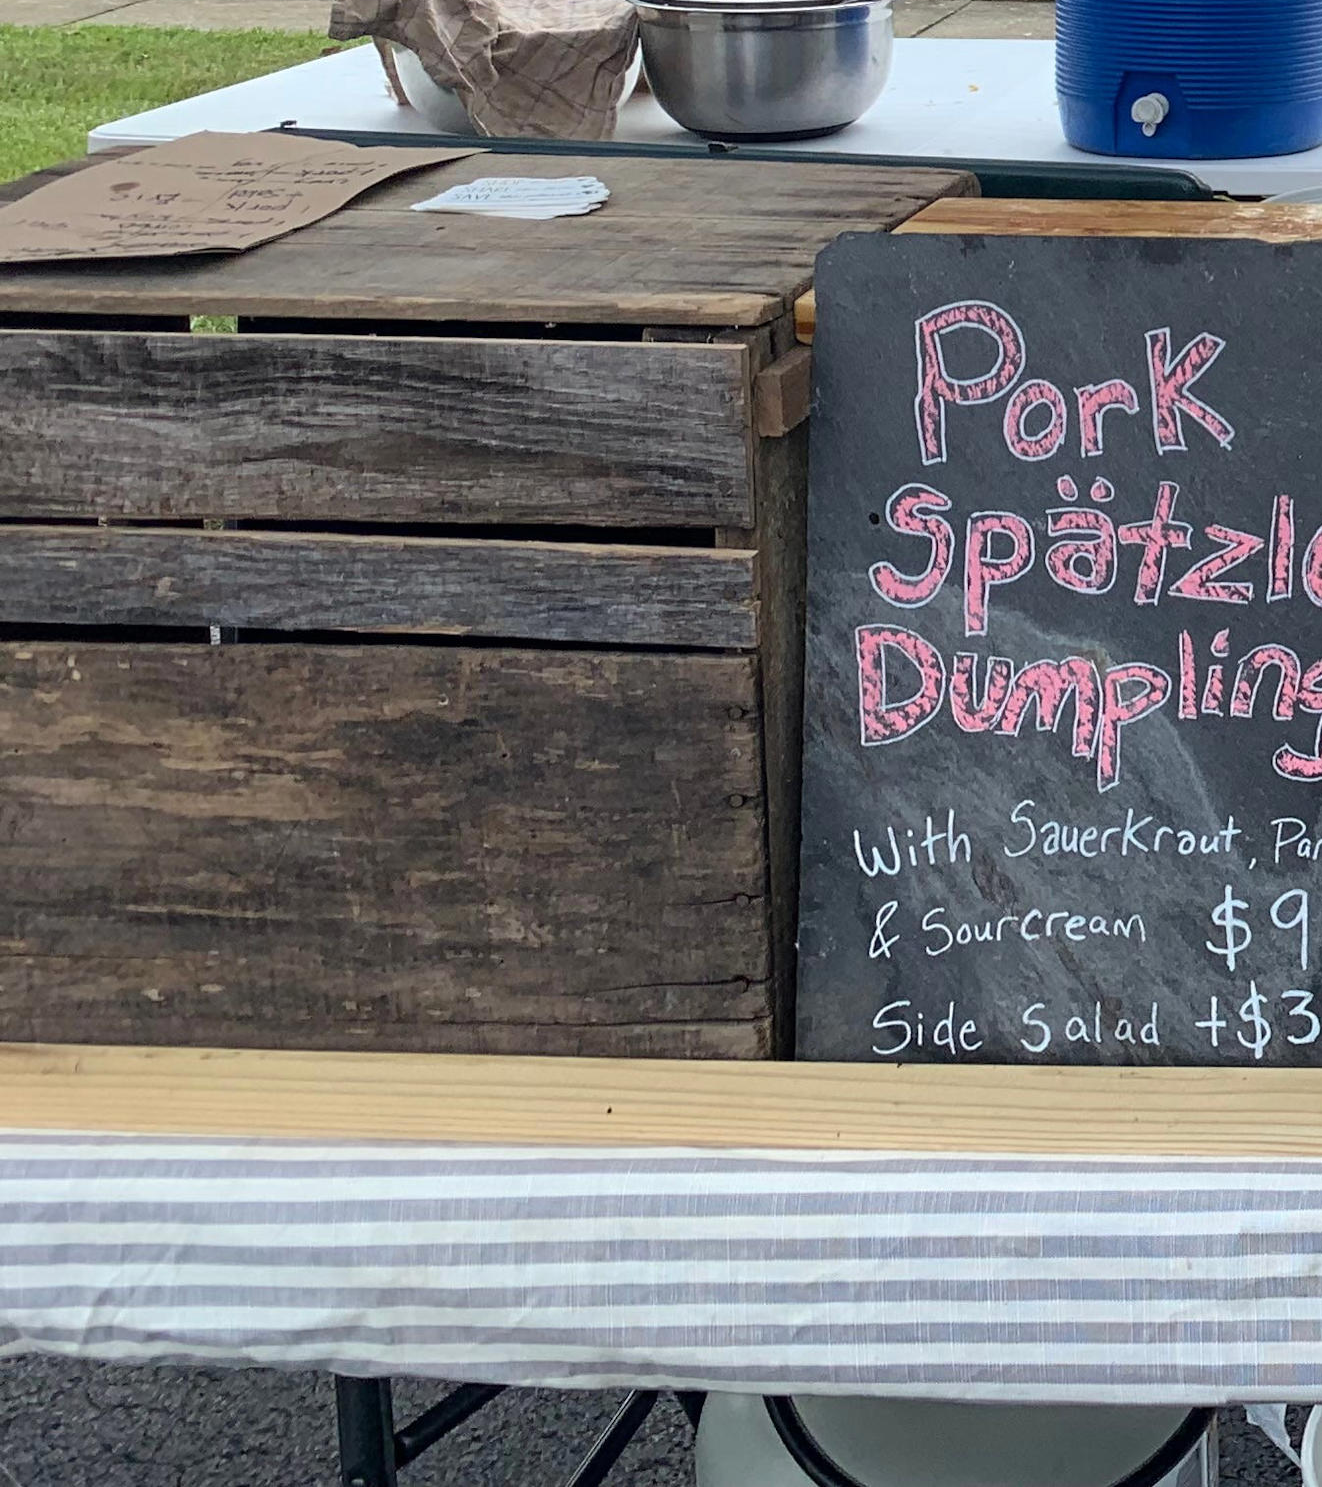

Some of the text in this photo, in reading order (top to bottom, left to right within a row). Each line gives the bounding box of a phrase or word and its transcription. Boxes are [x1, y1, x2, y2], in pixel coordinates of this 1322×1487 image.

[853, 809, 971, 878] With
[869, 900, 900, 960] &
[872, 1000, 983, 1056] Side
[1021, 1001, 1161, 1054] Salad
